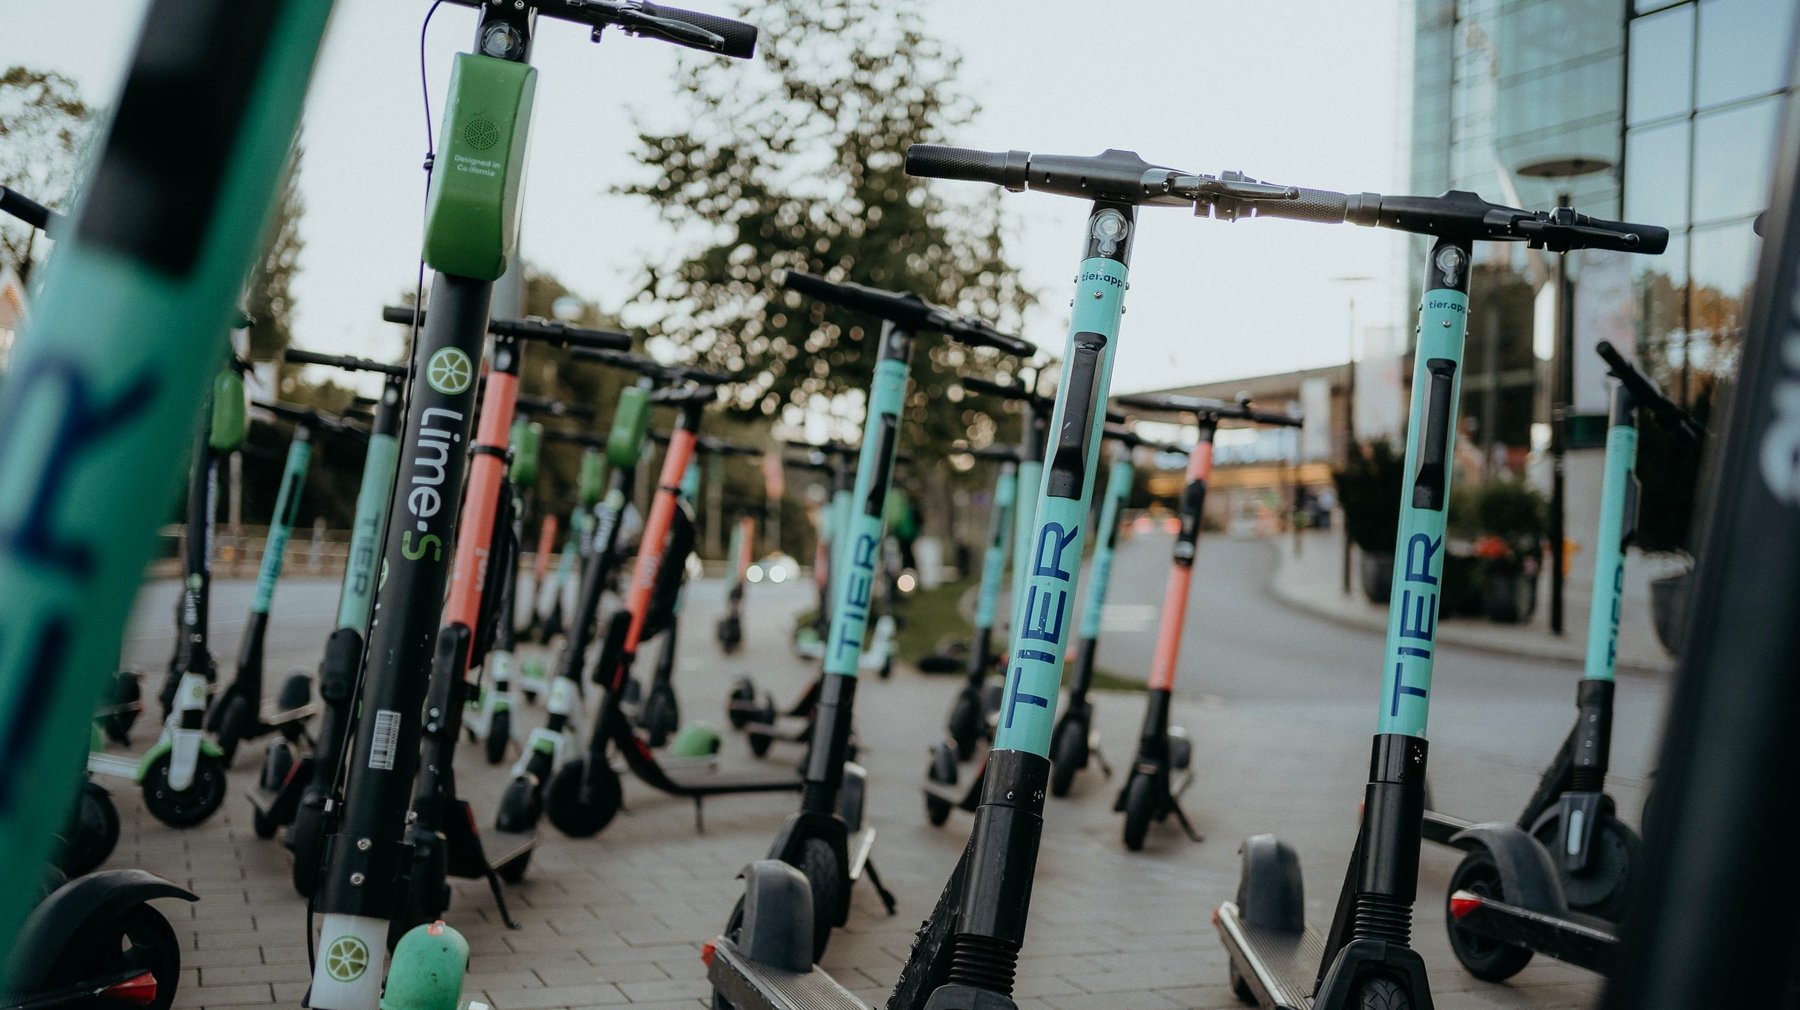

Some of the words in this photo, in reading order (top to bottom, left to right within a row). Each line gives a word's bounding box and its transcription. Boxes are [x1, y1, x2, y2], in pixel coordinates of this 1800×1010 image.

[454, 154, 491, 167] Designed
[492, 161, 500, 169] in
[457, 164, 494, 176] Caifornia
[1081, 271, 1123, 288] tier.app
[836, 533, 878, 661] TIER
[1004, 521, 1079, 729] TIER
[1390, 532, 1442, 717] TIER
